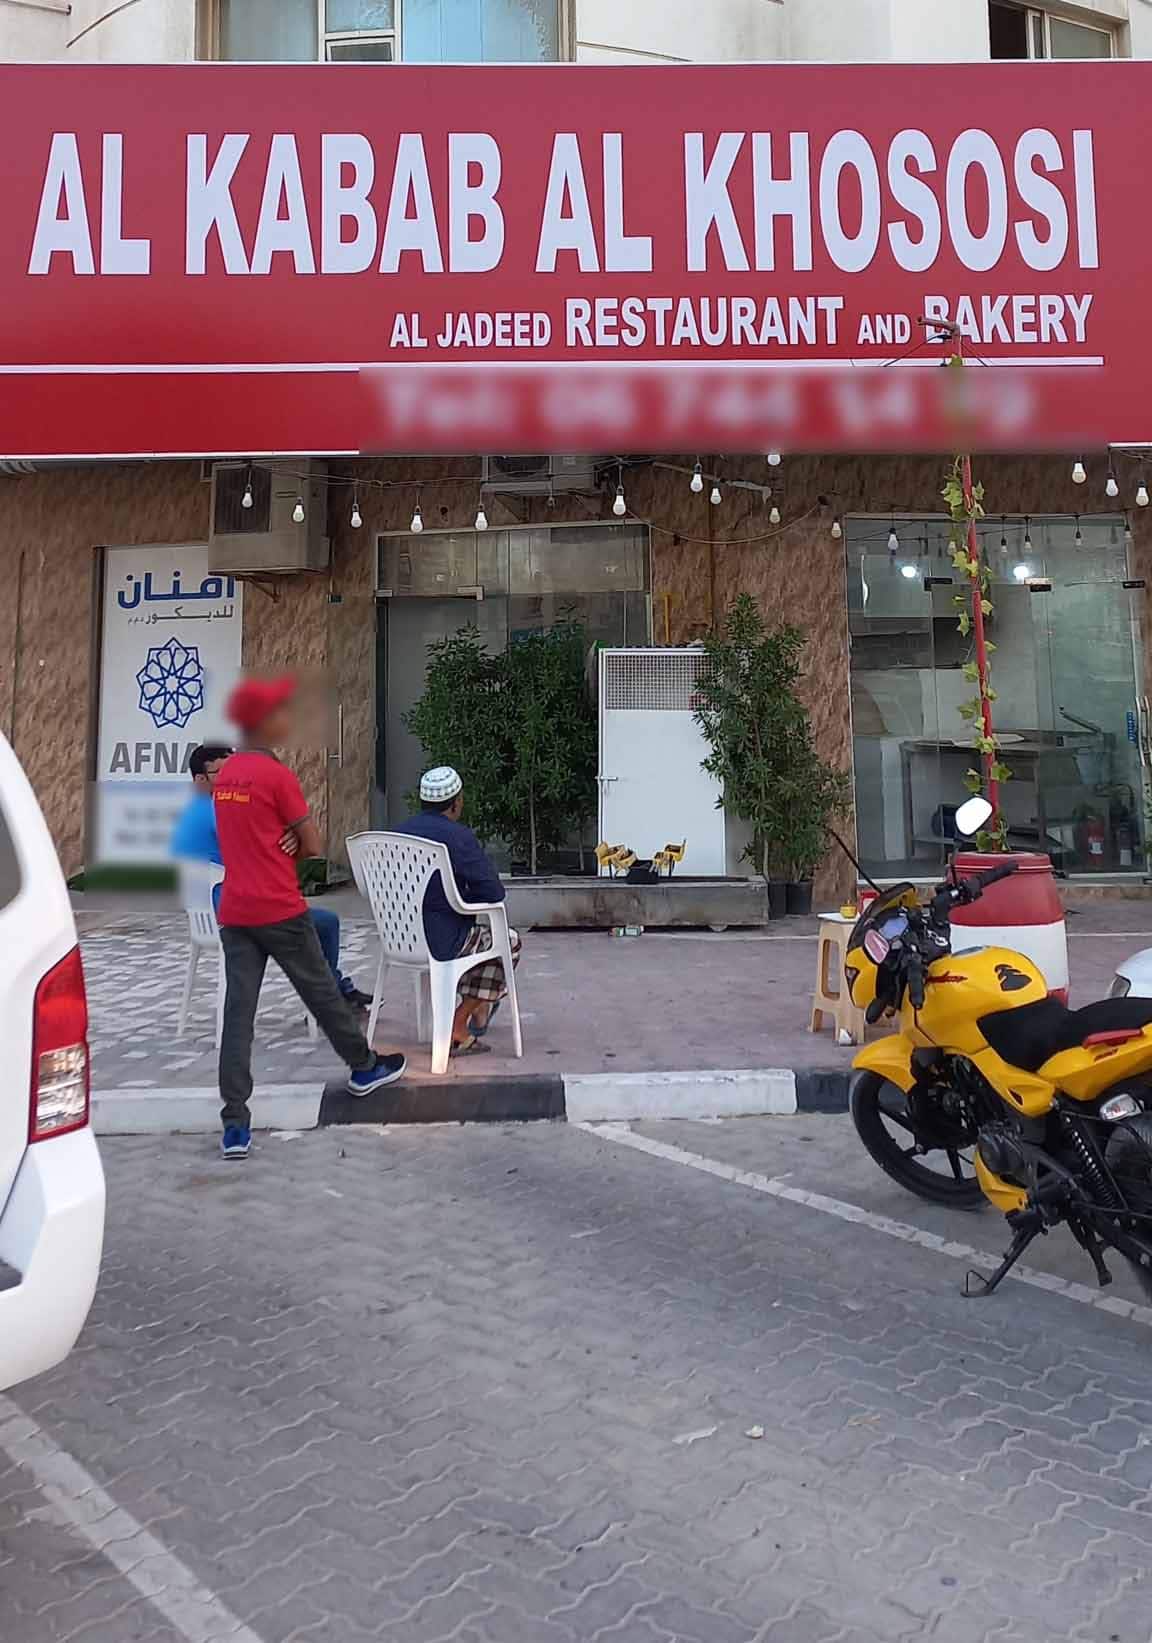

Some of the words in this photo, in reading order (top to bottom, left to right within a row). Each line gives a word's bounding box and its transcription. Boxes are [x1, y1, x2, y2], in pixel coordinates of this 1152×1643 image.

[27, 132, 151, 275] AL
[185, 132, 505, 275] KABAB
[535, 132, 654, 273] AL
[683, 128, 1099, 273] KHOSOSI
[389, 313, 428, 347] AL
[436, 312, 551, 347] JADEED
[565, 296, 844, 347] RESTAURANT
[857, 314, 911, 344] AND
[923, 294, 1094, 344] BAKERY
